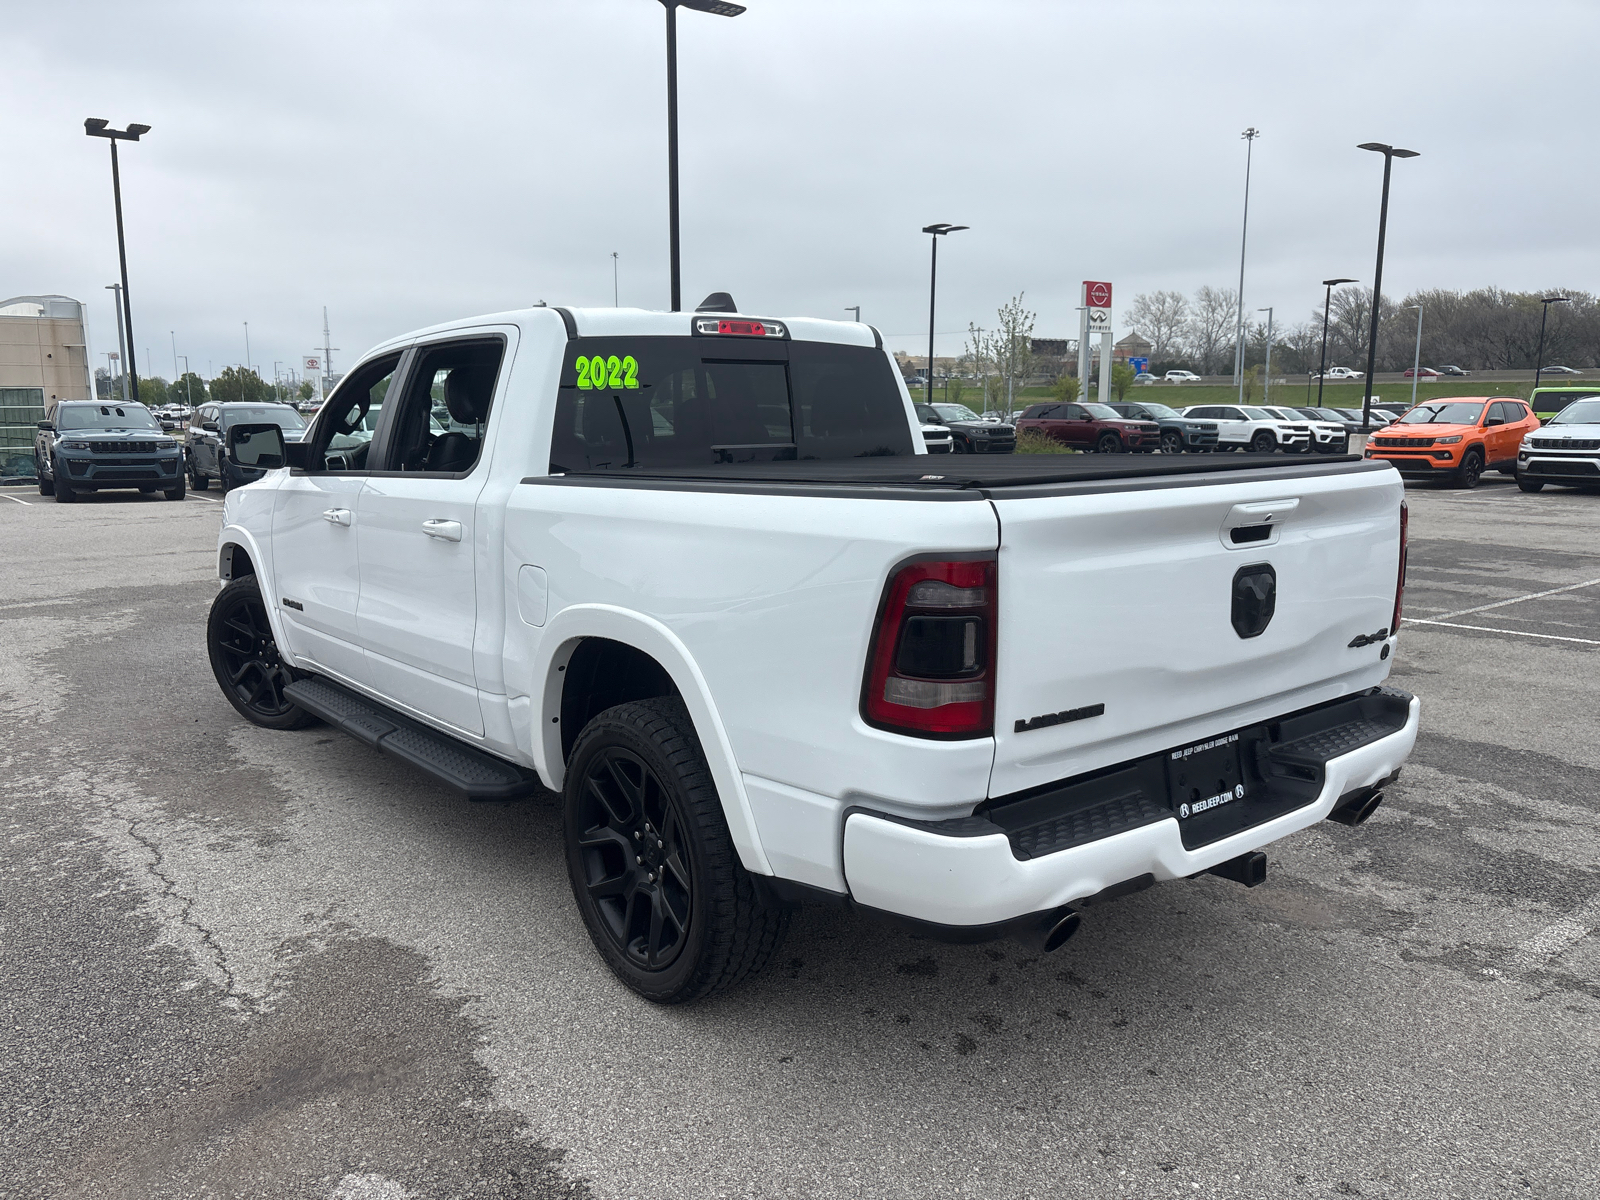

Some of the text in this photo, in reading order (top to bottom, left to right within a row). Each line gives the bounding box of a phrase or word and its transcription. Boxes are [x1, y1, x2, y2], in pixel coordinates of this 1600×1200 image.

[575, 355, 639, 391] 2022
[1171, 733, 1239, 760] REED JEEP CHRYSLER DODGE RAM
[1191, 791, 1233, 814] REEDJEEP.COM
